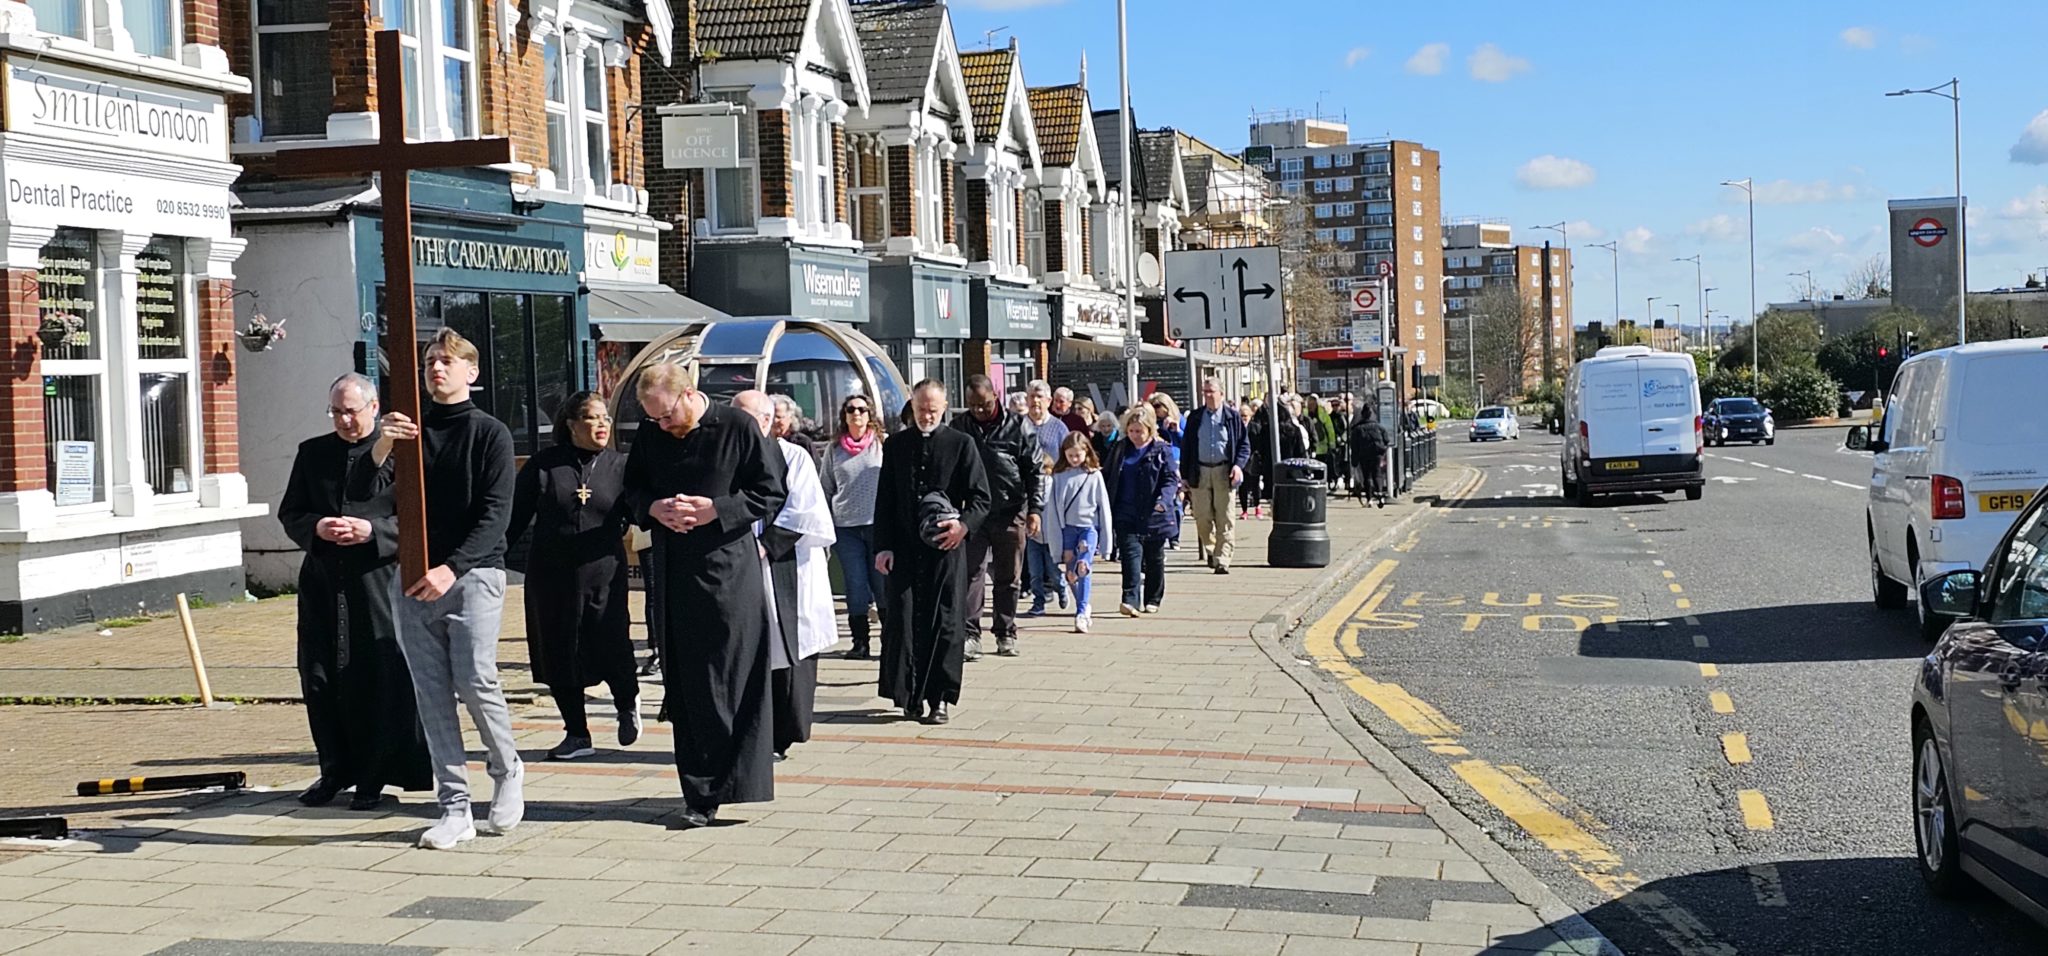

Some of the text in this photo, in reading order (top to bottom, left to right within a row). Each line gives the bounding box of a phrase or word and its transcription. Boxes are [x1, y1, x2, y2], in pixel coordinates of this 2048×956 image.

[671, 147, 729, 159] LICENCE
[686, 135, 713, 147] OFF
[9, 178, 133, 214] Dental Practice
[156, 198, 225, 220] 020 8532 9990
[414, 236, 571, 274] THE CARDAMOM ROOM
[844, 268, 861, 296] Lee
[937, 288, 951, 319] W
[1989, 495, 2025, 510] GF19
